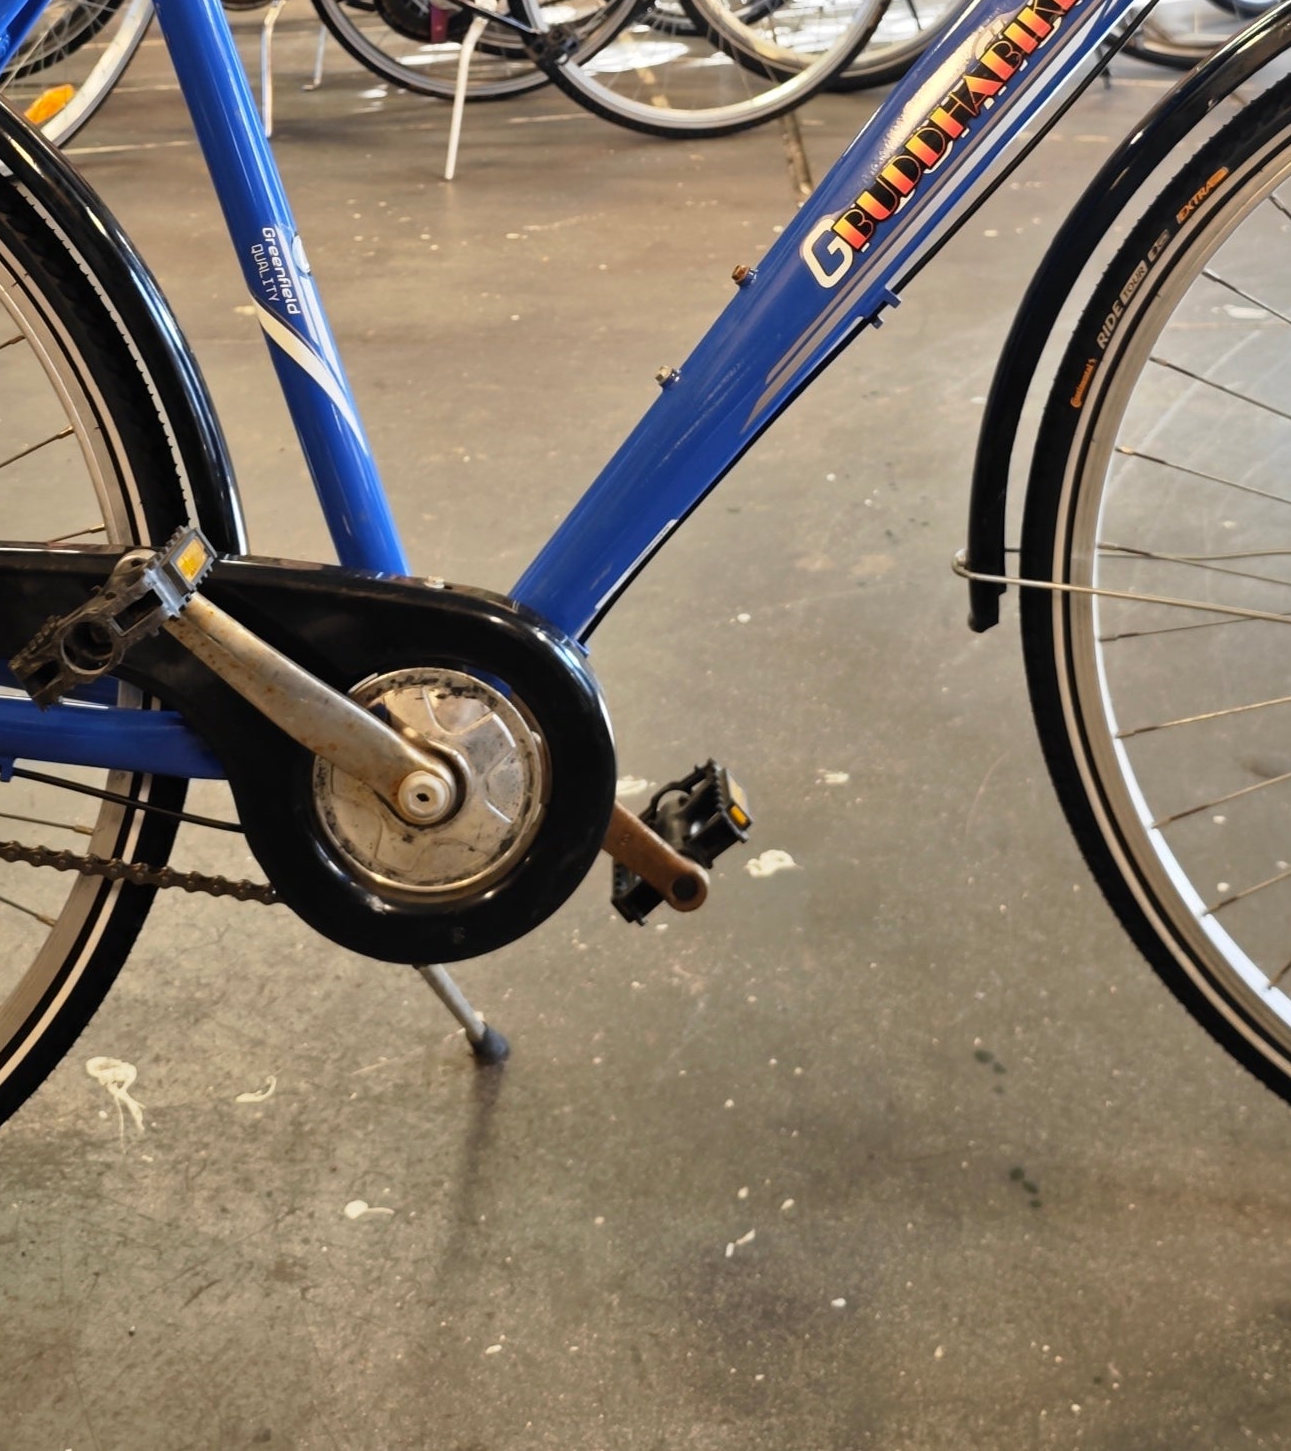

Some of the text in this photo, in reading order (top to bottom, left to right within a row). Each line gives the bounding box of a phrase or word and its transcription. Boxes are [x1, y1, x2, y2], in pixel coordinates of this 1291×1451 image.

[250, 243, 281, 302] QUALITY
[262, 227, 301, 315] Greenfield
[1096, 299, 1124, 351] RIDE
[1123, 265, 1147, 300] TOUR
[1177, 179, 1217, 226] EXTRA
